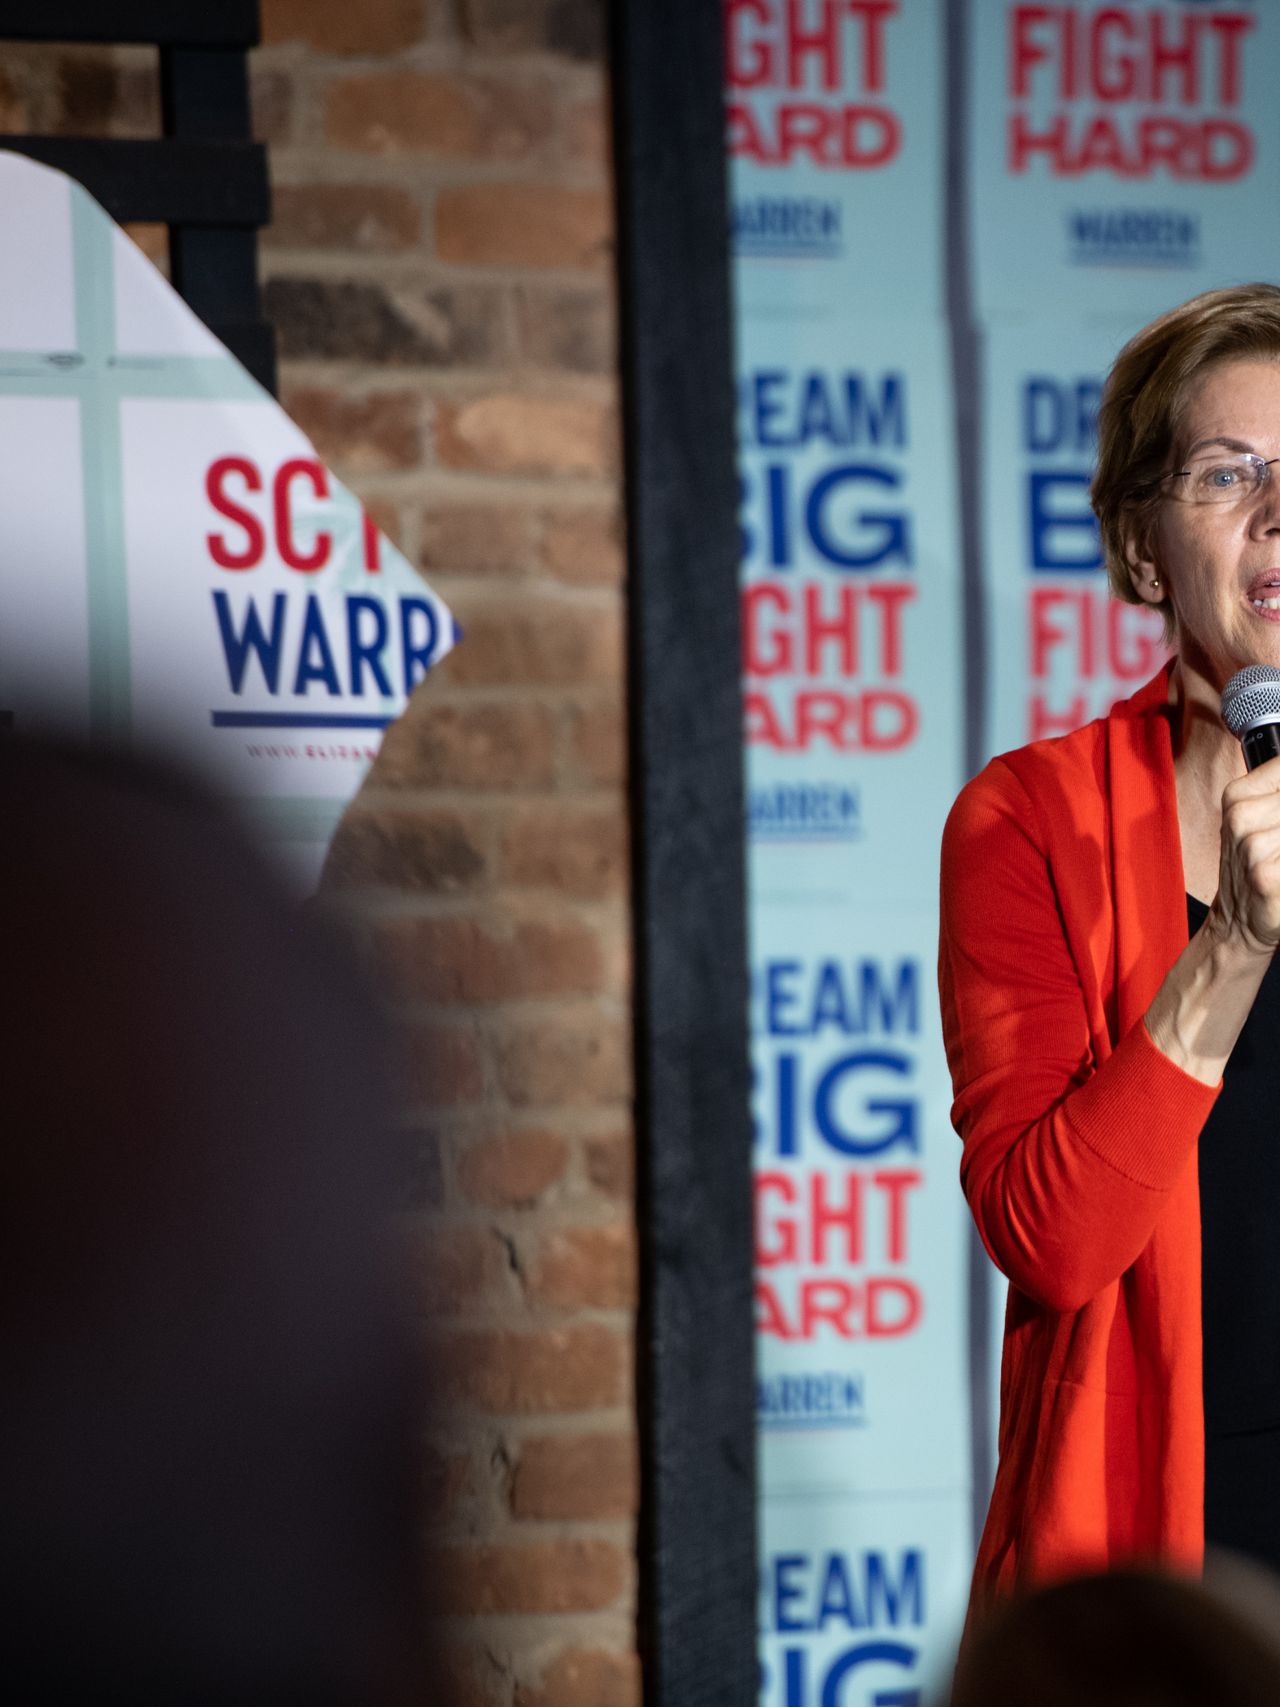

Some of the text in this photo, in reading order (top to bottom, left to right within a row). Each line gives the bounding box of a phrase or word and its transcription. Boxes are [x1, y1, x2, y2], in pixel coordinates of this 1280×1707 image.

[1009, 6, 1256, 106] FIGHT
[1008, 113, 1254, 182] HARD
[740, 465, 911, 570] IG
[210, 589, 464, 698] WARR
[752, 958, 919, 1036] EAM
[752, 1052, 920, 1156] IG
[760, 1549, 925, 1633] EAM
[760, 1640, 922, 1707] IG
